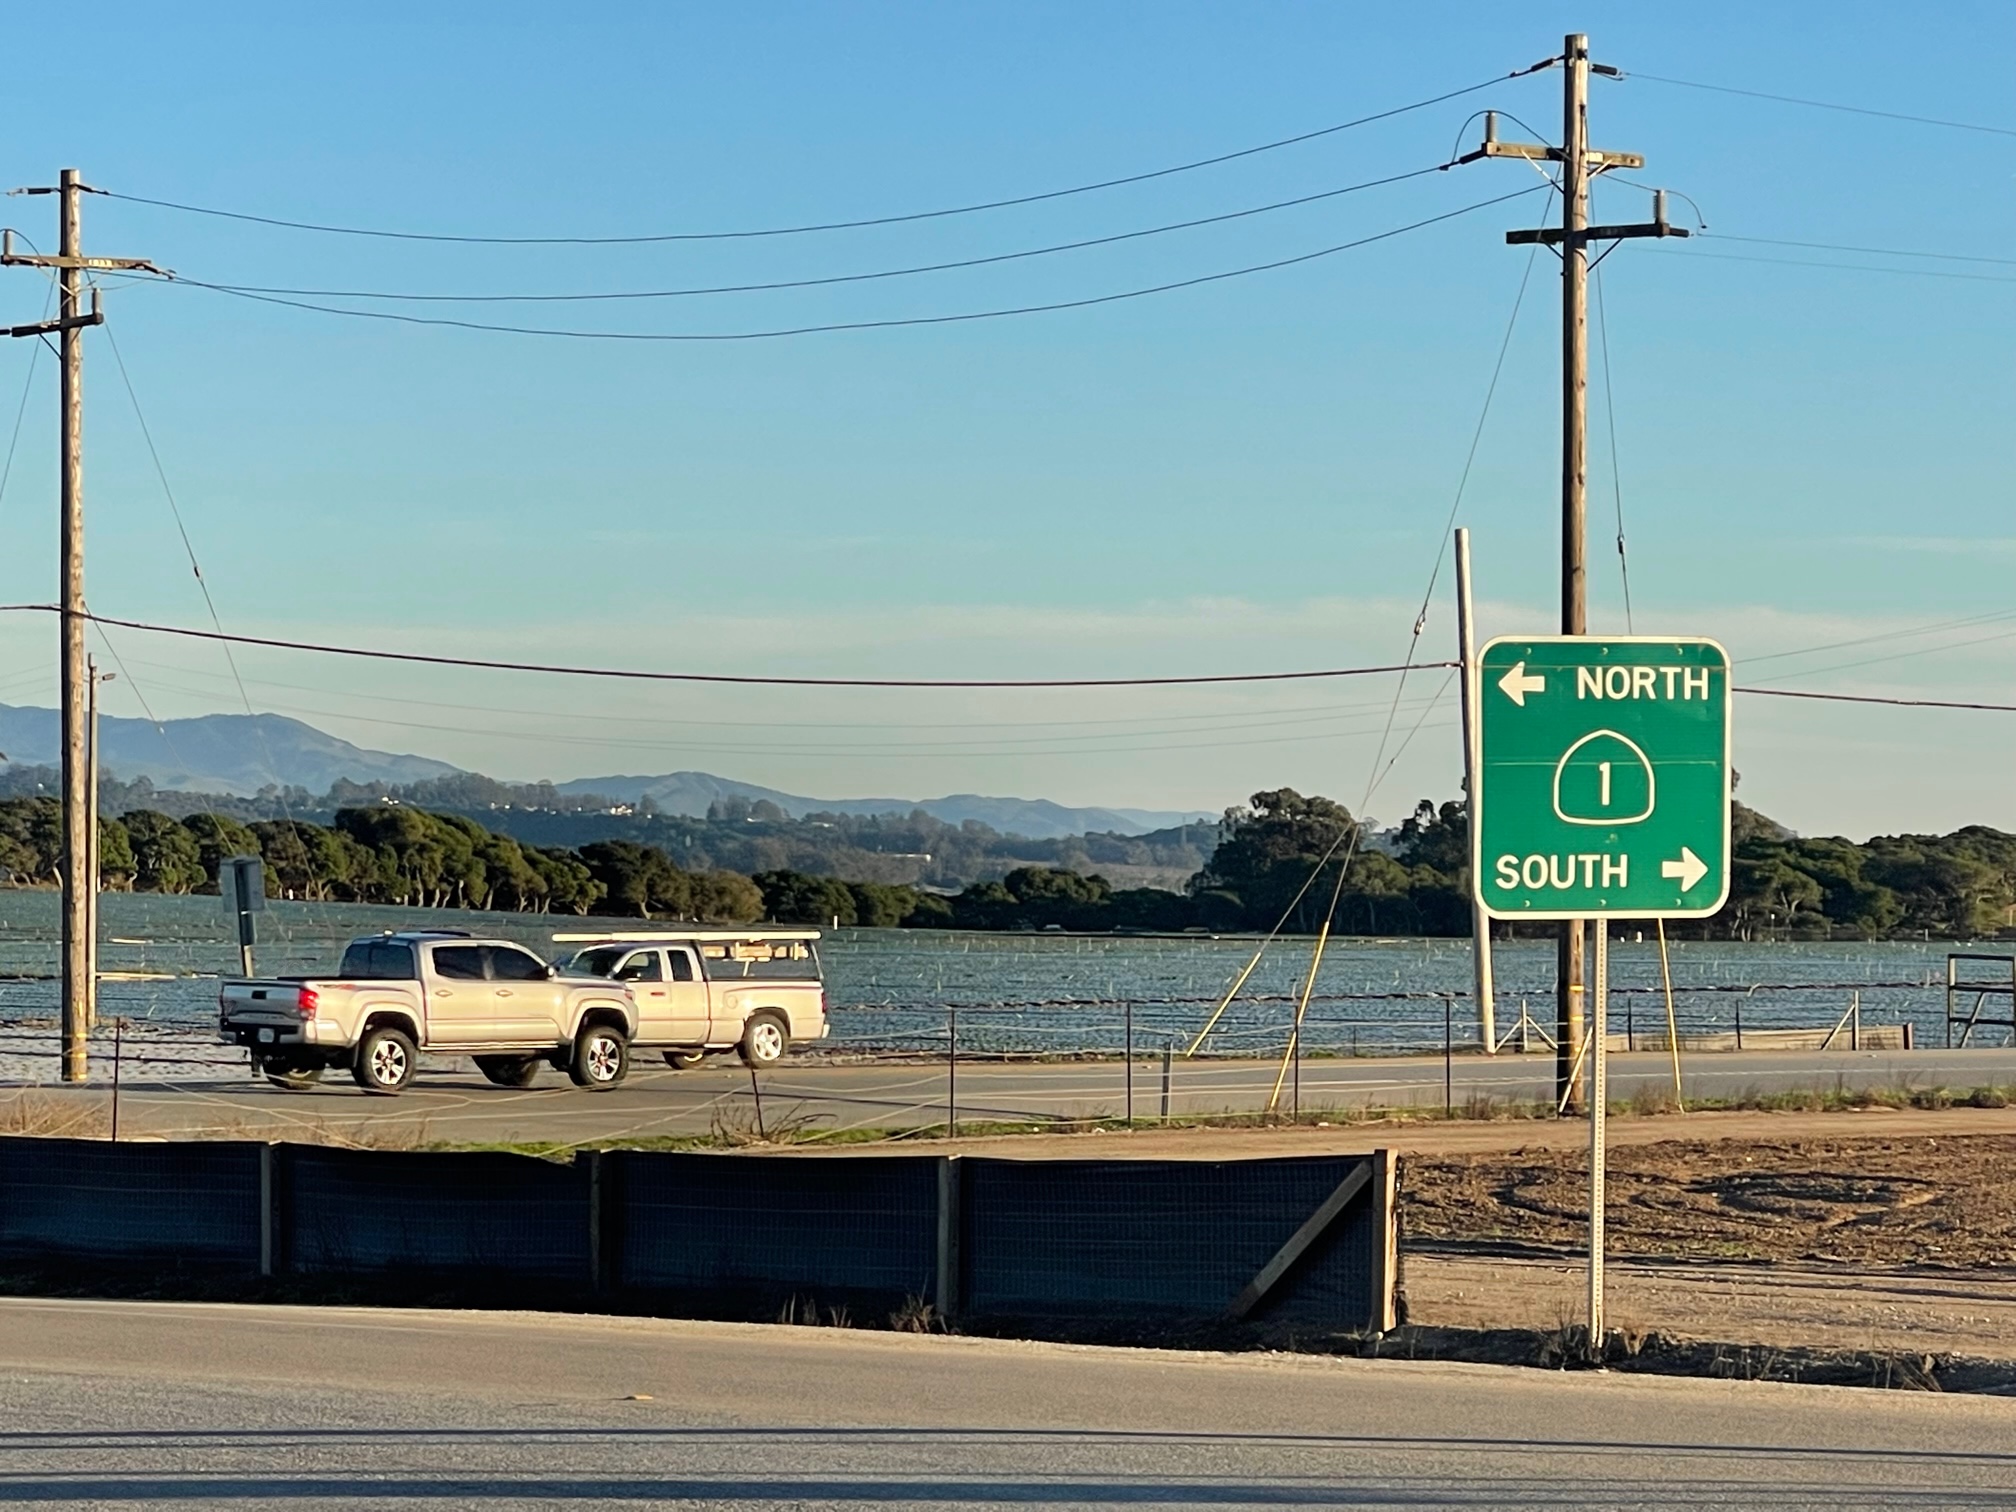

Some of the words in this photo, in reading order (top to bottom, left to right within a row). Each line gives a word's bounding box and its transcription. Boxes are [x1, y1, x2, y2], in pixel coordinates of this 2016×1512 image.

[1577, 666, 1709, 700] NORTH
[1599, 762, 1611, 806] 1
[1495, 854, 1628, 890] SOUTH
